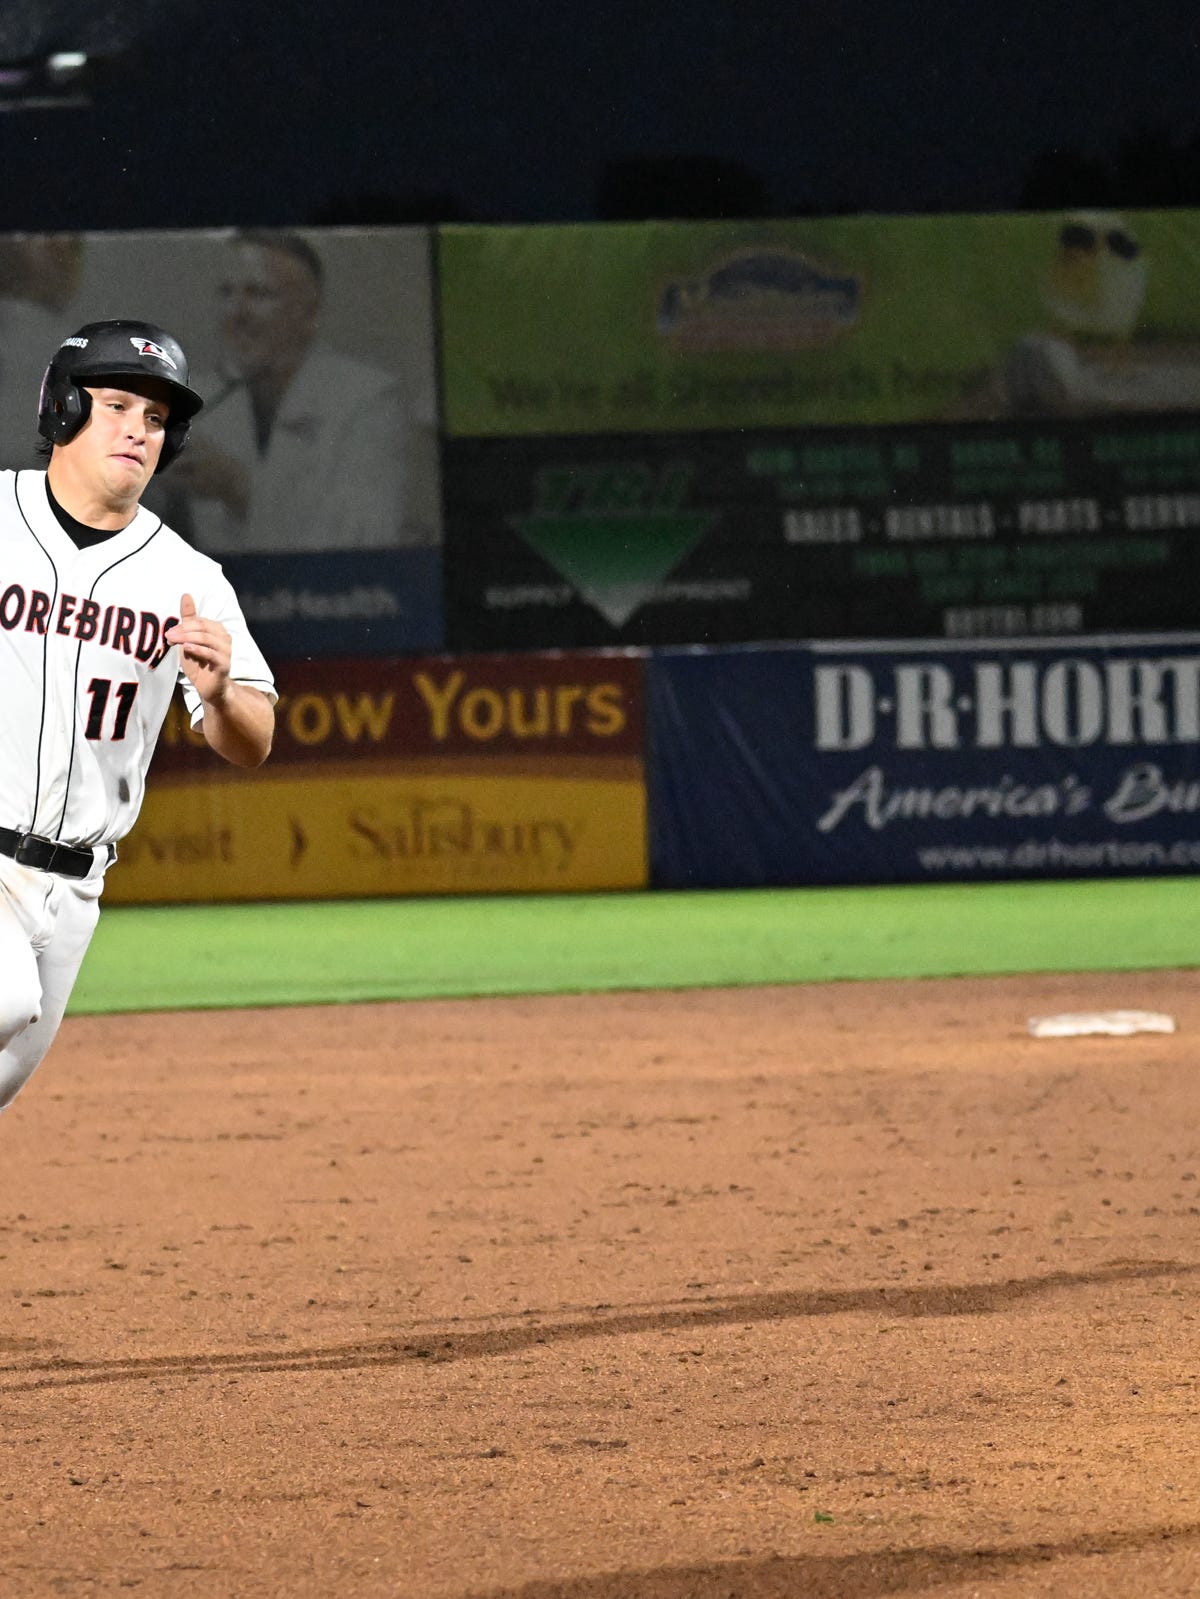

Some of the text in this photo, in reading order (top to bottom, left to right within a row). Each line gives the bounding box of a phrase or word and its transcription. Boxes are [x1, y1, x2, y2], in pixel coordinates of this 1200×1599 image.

[84, 677, 139, 742] 11
[413, 669, 628, 742] Yours
[816, 764, 1093, 833] America's
